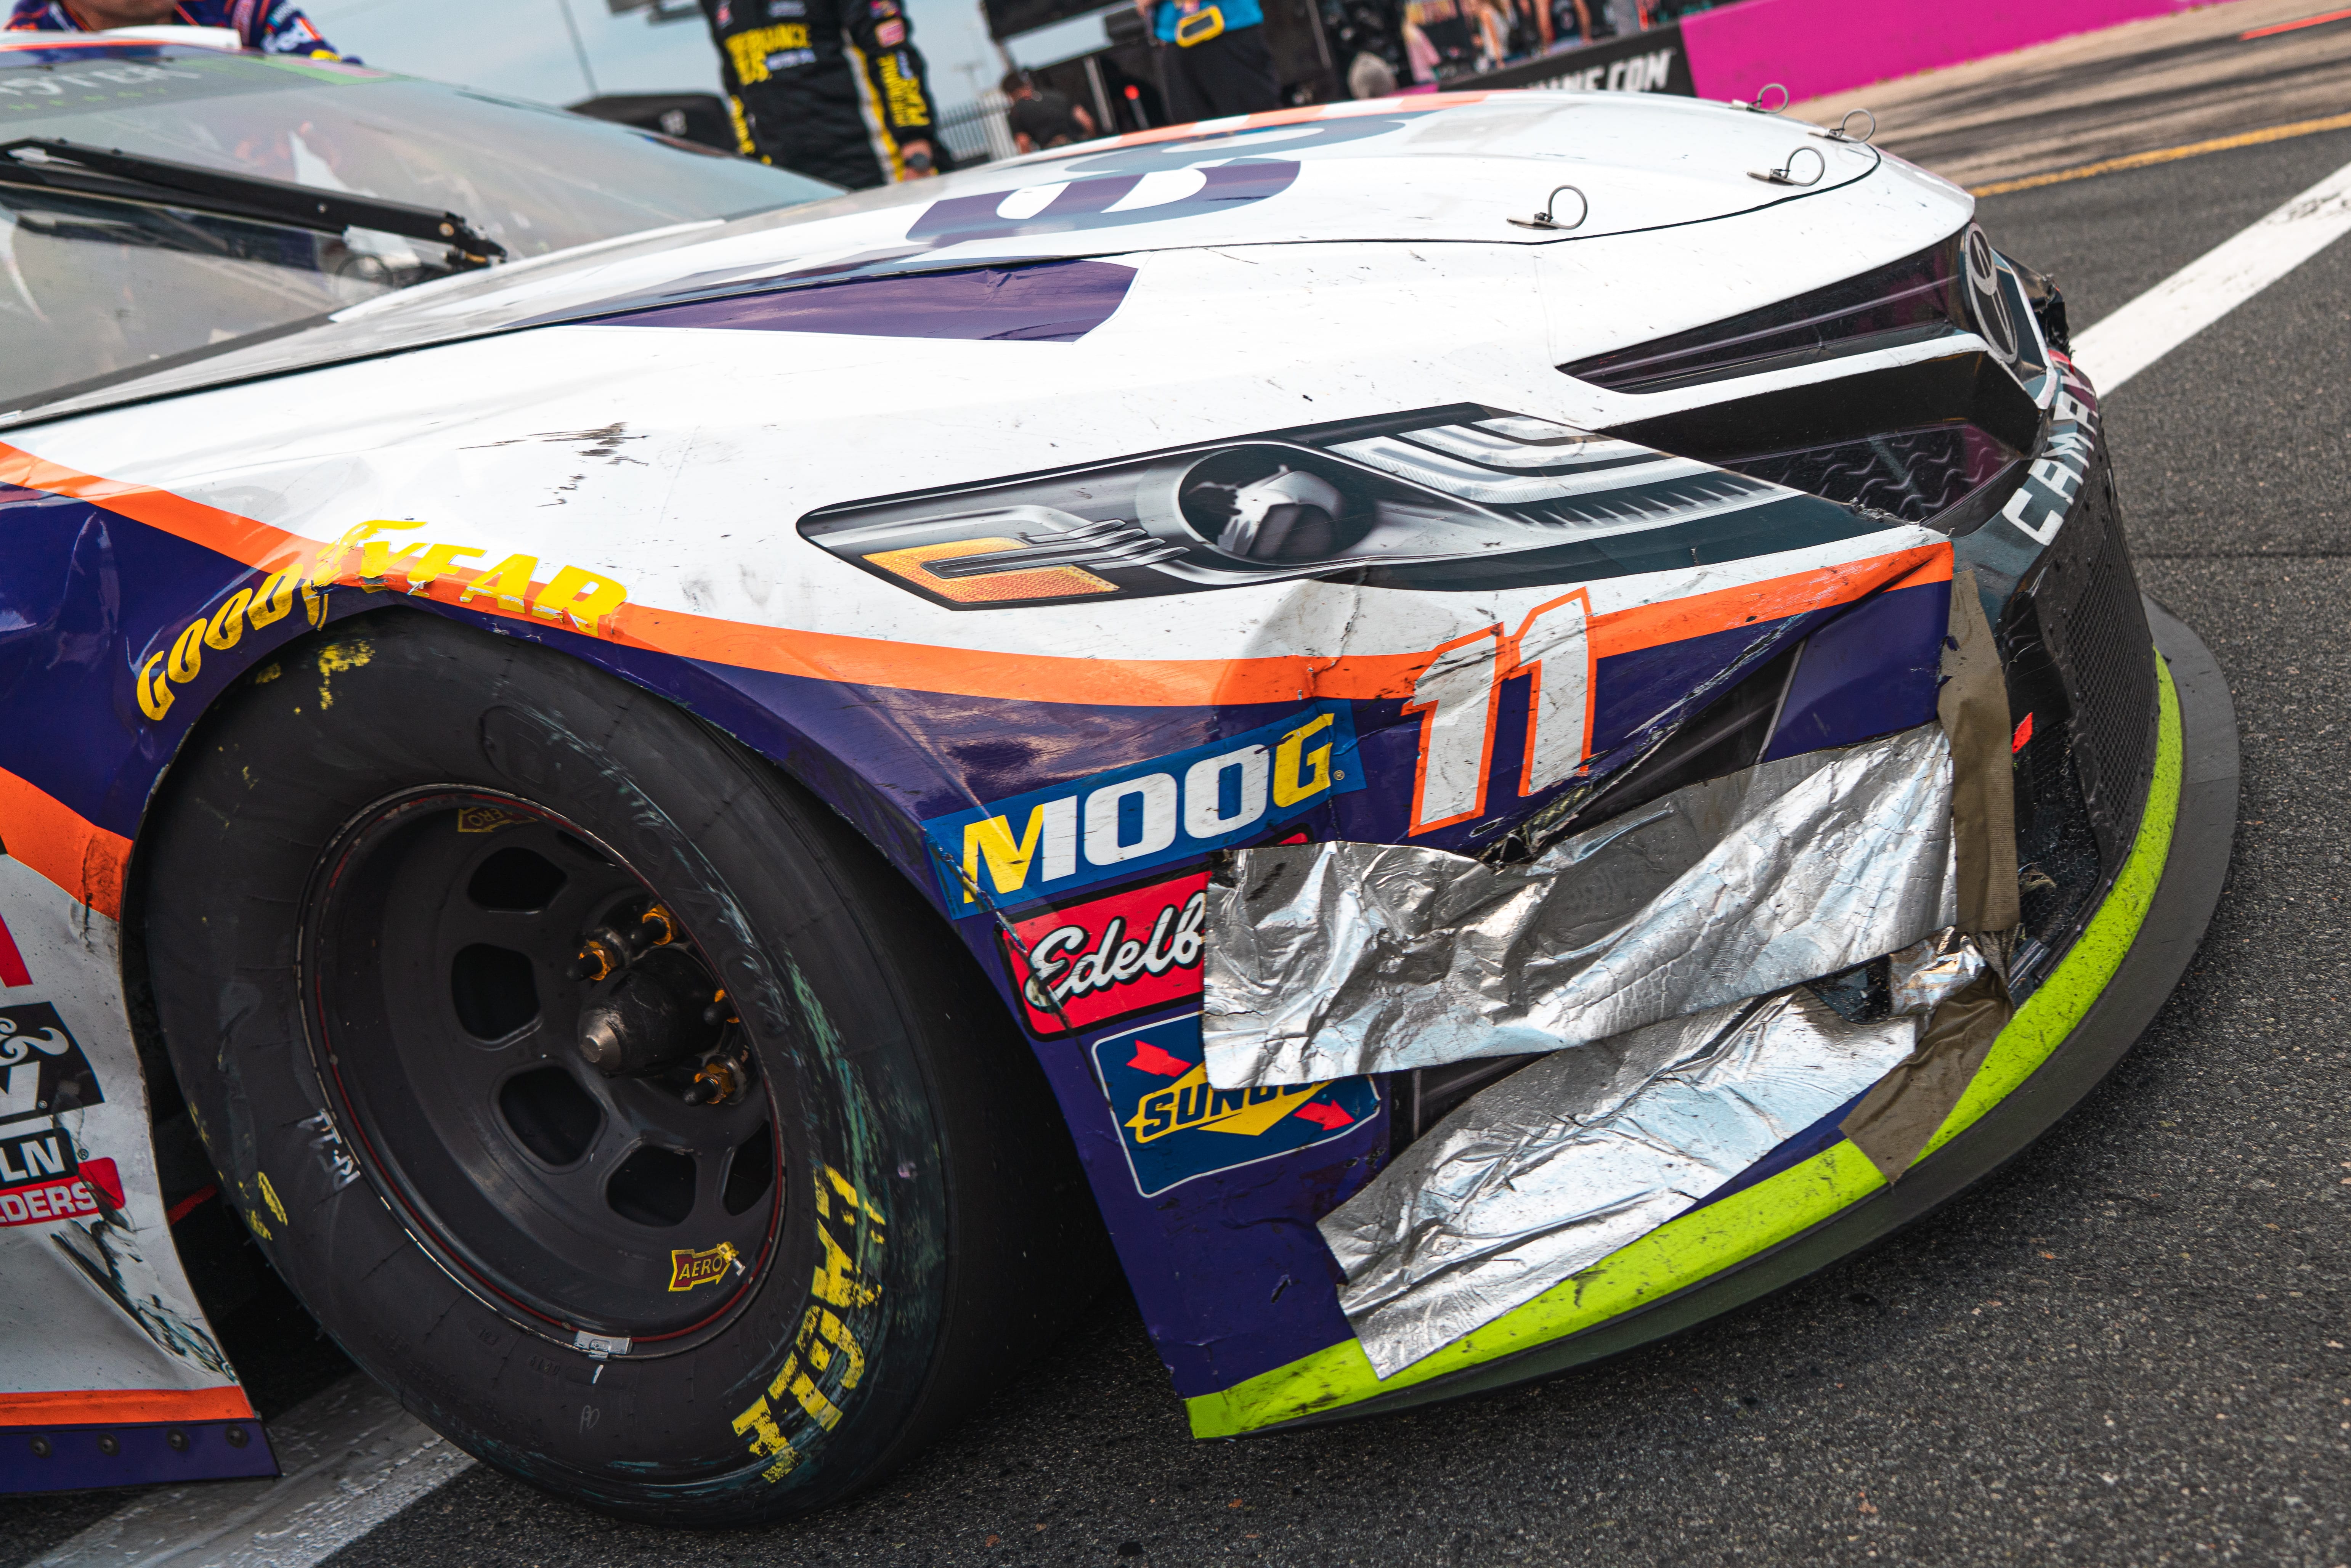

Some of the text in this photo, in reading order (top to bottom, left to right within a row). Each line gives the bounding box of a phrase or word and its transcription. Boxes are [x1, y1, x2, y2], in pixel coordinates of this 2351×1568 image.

[1401, 586, 1597, 837] 11
[963, 713, 1335, 904] MOOG
[1024, 891, 1206, 1010] Edelb
[0, 1181, 98, 1223] DERS
[679, 1256, 723, 1280] AERO
